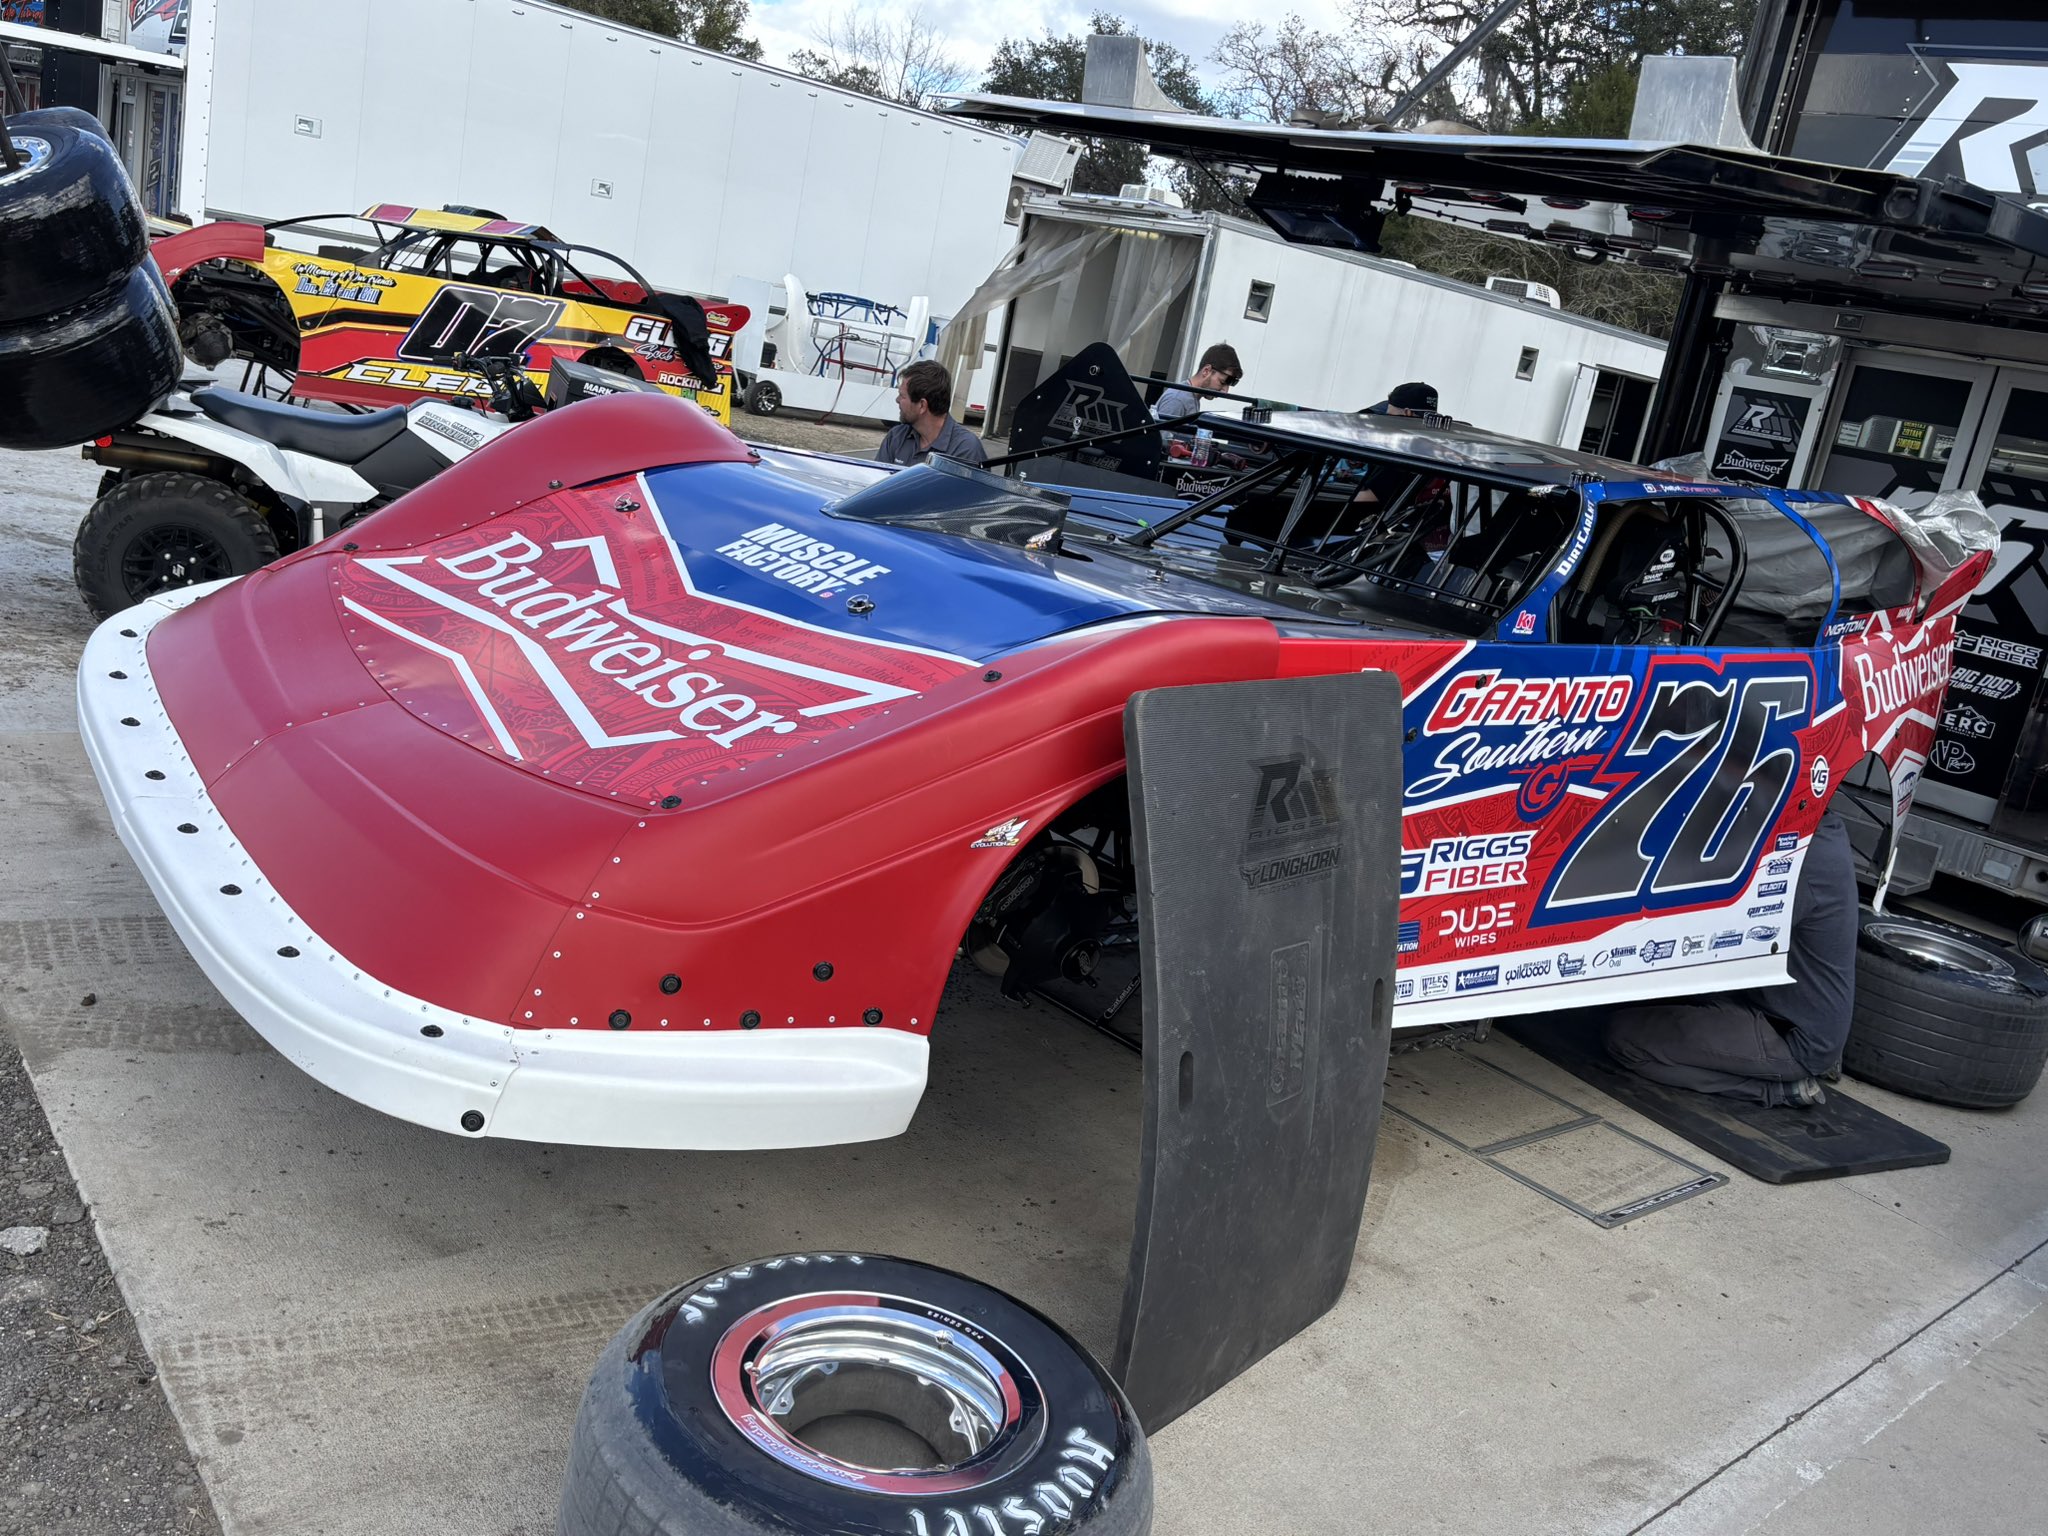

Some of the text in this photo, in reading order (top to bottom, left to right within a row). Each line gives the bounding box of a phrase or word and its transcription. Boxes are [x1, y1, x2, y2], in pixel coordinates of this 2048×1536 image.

[337, 286, 358, 300] and
[359, 286, 381, 304] Bill
[398, 284, 563, 365] 07
[583, 382, 613, 396] MARK
[418, 415, 480, 448] KINGQUAD
[1723, 453, 1784, 476] Budweiser
[715, 537, 841, 597] FACTORY
[740, 522, 891, 587] MUSCLE
[435, 529, 799, 750] Budweiser
[1980, 636, 2042, 657] RIGGS
[1976, 646, 2039, 669] FIBER
[1855, 628, 1956, 723] Budweiser
[1948, 680, 1973, 691] TUMP
[1978, 687, 2002, 699] TREE
[1950, 667, 2014, 692] BIG DOG
[1422, 668, 1634, 737] GARNTO
[1944, 713, 1988, 734] ERG
[1403, 715, 1608, 798] Southern
[1935, 740, 1966, 771] VP
[1545, 676, 1809, 911] 76
[1429, 834, 1531, 865] RIGGS
[1260, 848, 1342, 884] LONGHORN
[1424, 861, 1525, 892] FIBER
[1438, 901, 1517, 937] DUDE
[1454, 933, 1498, 949] WIPES
[1421, 975, 1449, 993] WILES
[1465, 969, 1498, 980] ALLSTAR
[1504, 960, 1552, 985] wilwood
